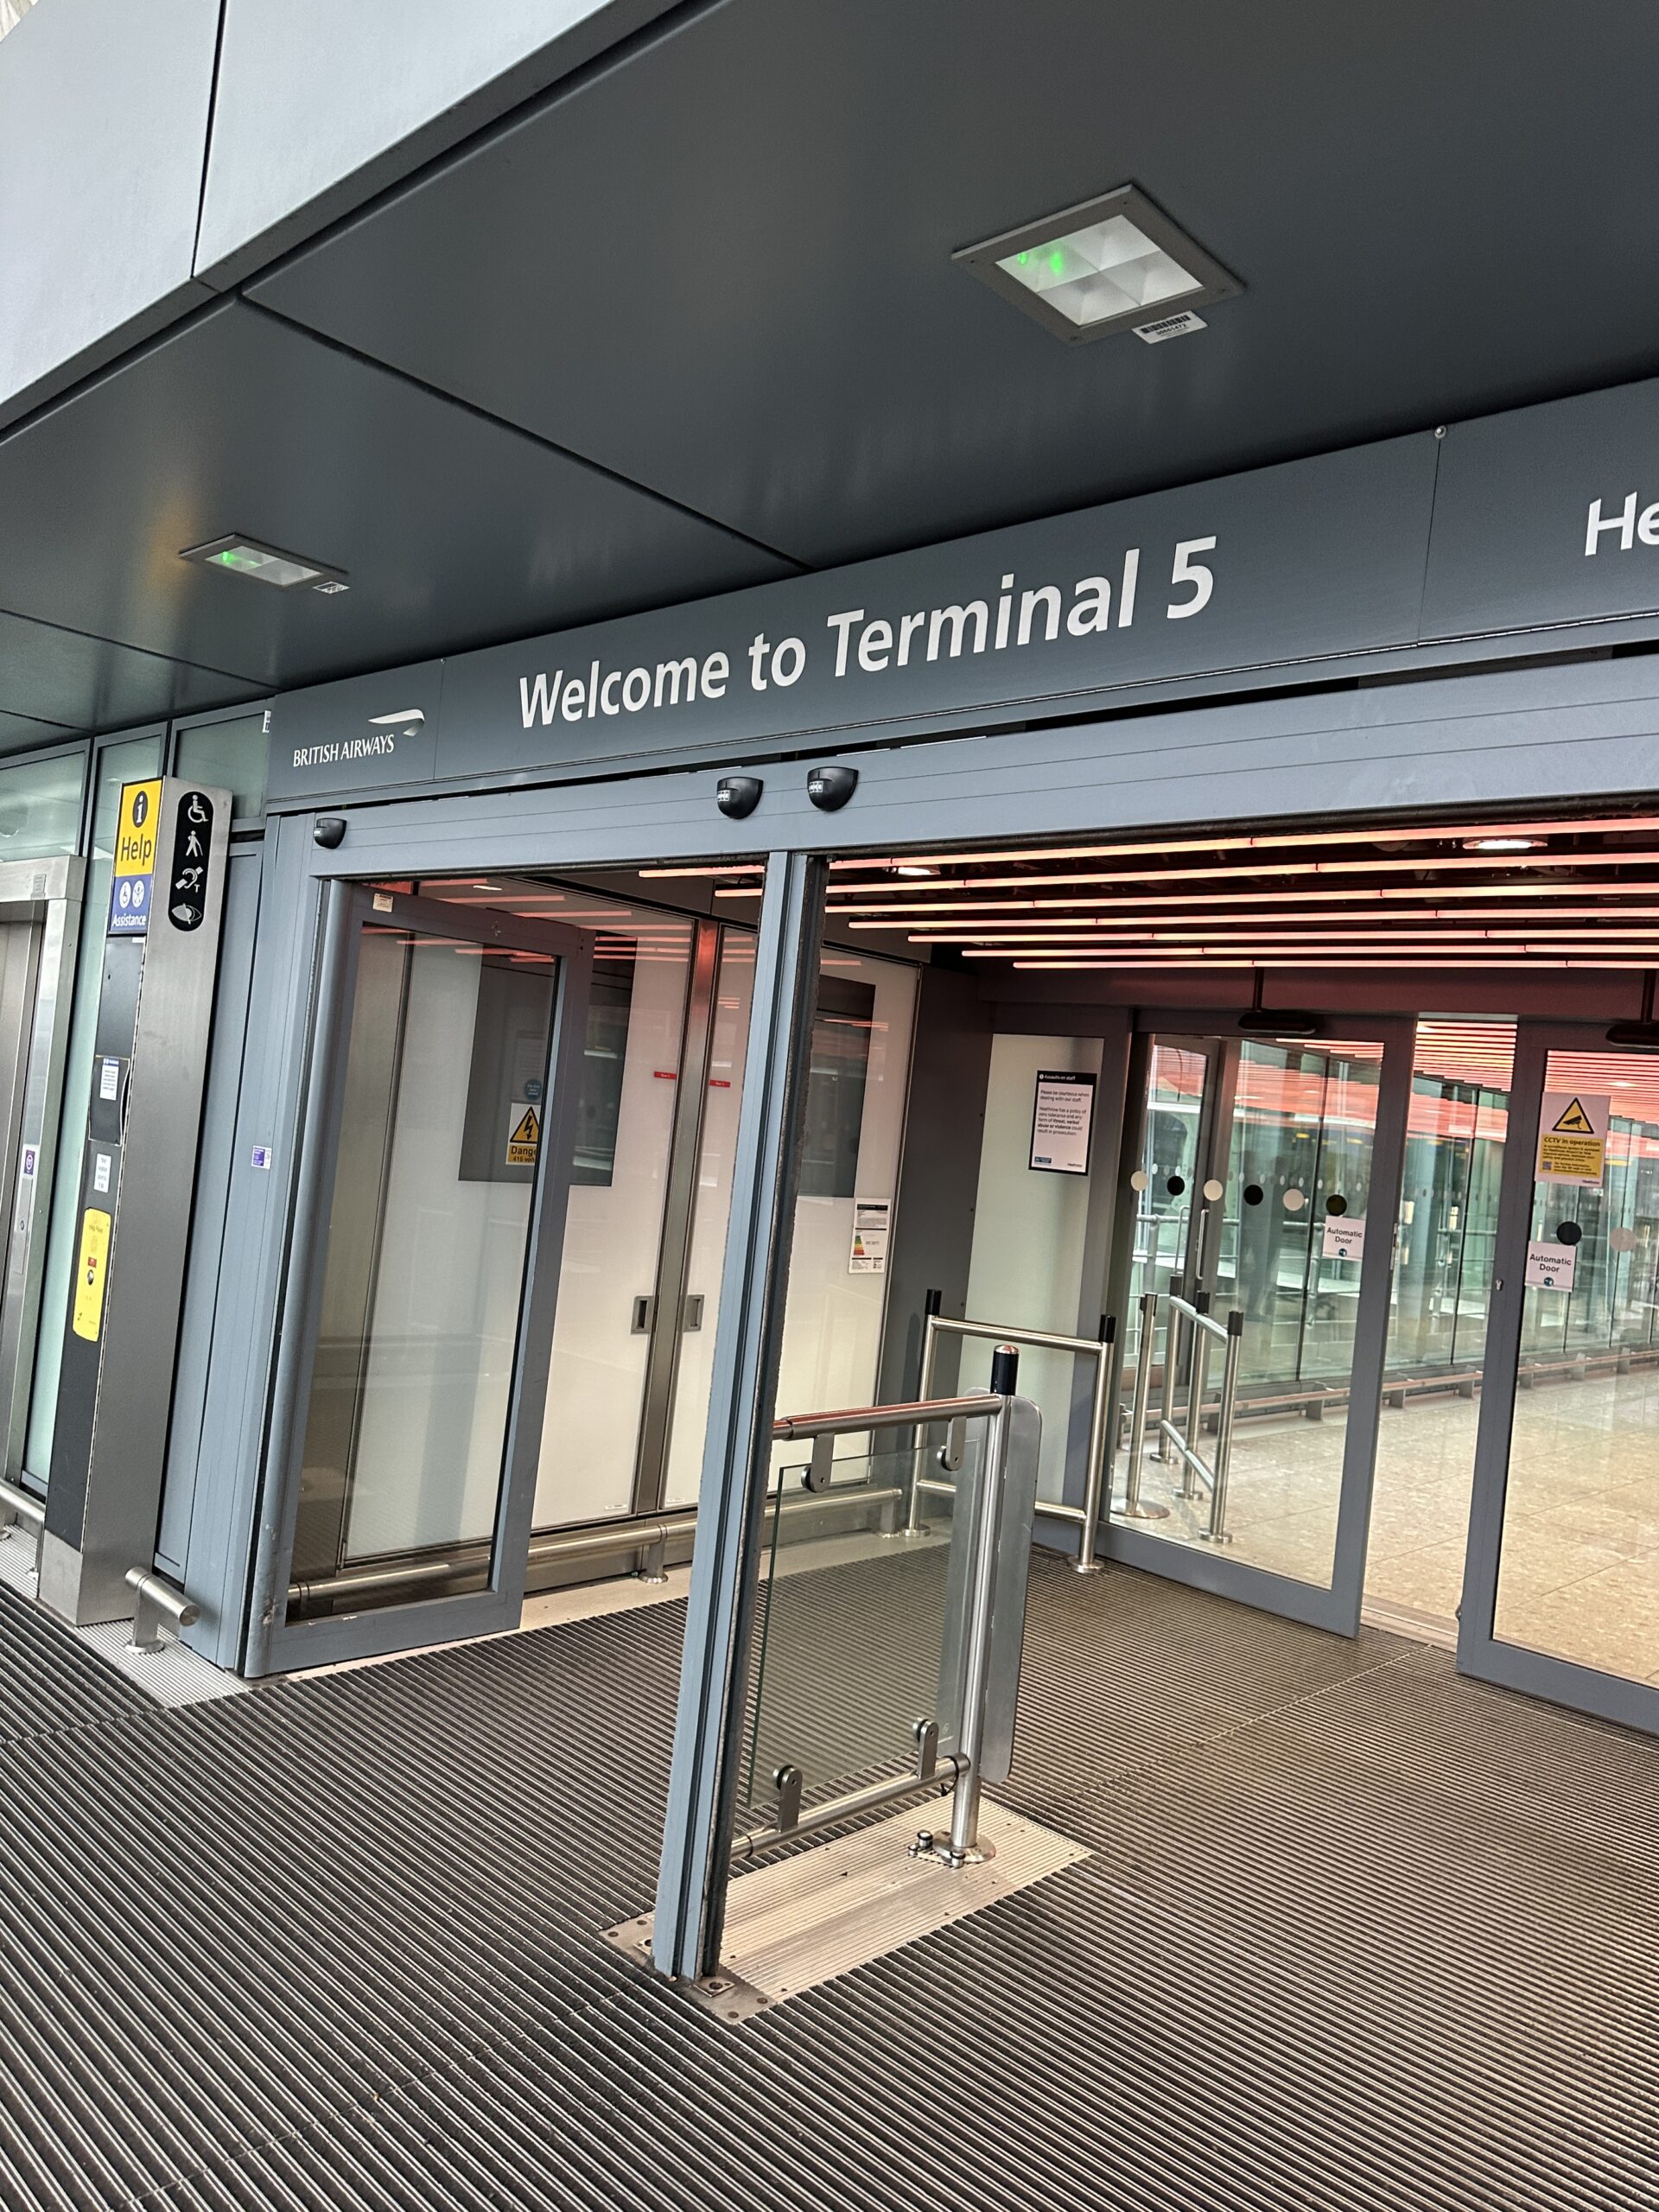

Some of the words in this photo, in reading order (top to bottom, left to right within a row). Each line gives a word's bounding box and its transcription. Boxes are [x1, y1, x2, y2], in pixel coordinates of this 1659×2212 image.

[519, 652, 729, 728] Welcome
[748, 632, 806, 691] to
[827, 548, 1140, 677] Terminal
[1166, 536, 1217, 620] 5
[293, 743, 340, 767] BRITISH
[340, 734, 395, 760] AIRWAYS
[120, 833, 152, 866] Help
[111, 912, 146, 927] Assistance
[511, 1146, 537, 1158] Dang
[1326, 1227, 1363, 1237] Automatic
[1529, 1253, 1572, 1266] Automatic
[1539, 1263, 1560, 1273] Door
